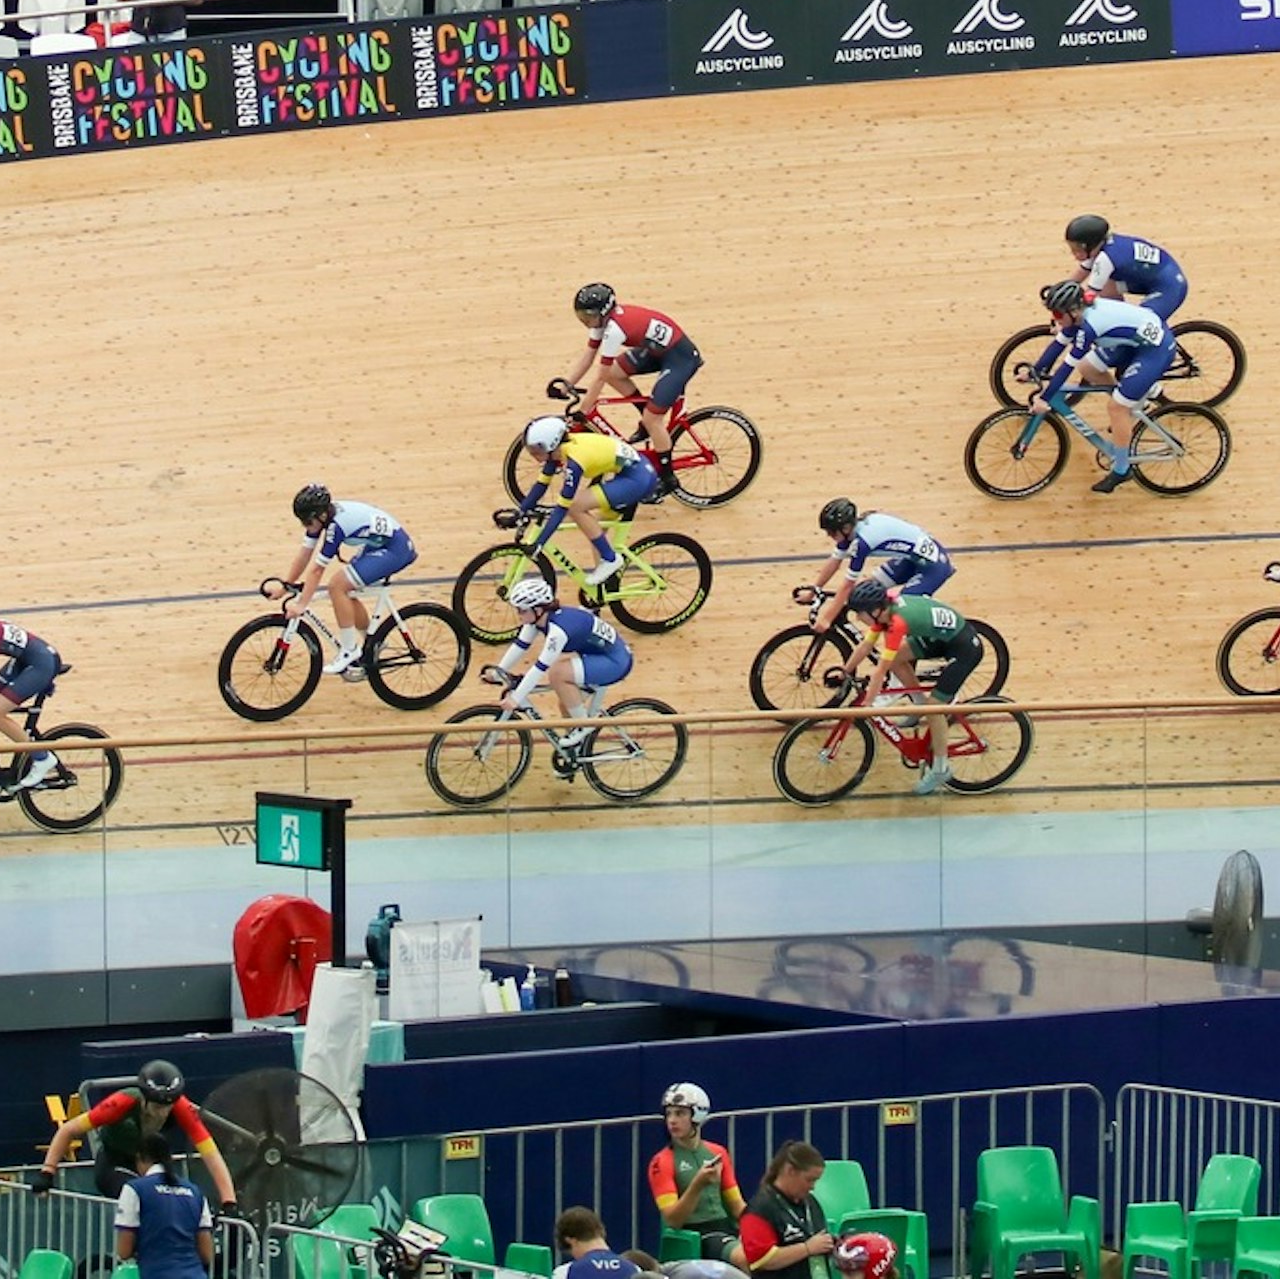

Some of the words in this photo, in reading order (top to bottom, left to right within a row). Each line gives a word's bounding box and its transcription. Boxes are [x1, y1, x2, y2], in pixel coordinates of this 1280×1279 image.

[256, 29, 392, 83] CYCLING
[437, 11, 572, 66] CYCLING
[835, 42, 923, 64] AUSCYCLING
[947, 34, 1035, 56] AUSCYCLING
[1059, 27, 1147, 48] AUSCYCLING
[74, 47, 209, 103] CYCLING
[231, 42, 259, 128] BRISBANE
[411, 24, 439, 110] BRISBANE
[441, 58, 576, 108] FESTIVAL
[695, 54, 784, 75] AUSCYCLING
[47, 62, 76, 149] BRISBANE
[78, 93, 214, 145] FESTIVAL
[261, 75, 397, 125] FESTIVAL
[654, 323, 667, 341] 93
[889, 1107, 910, 1118] TFH
[450, 1140, 474, 1151] TFH
[591, 1259, 621, 1270] VIC
